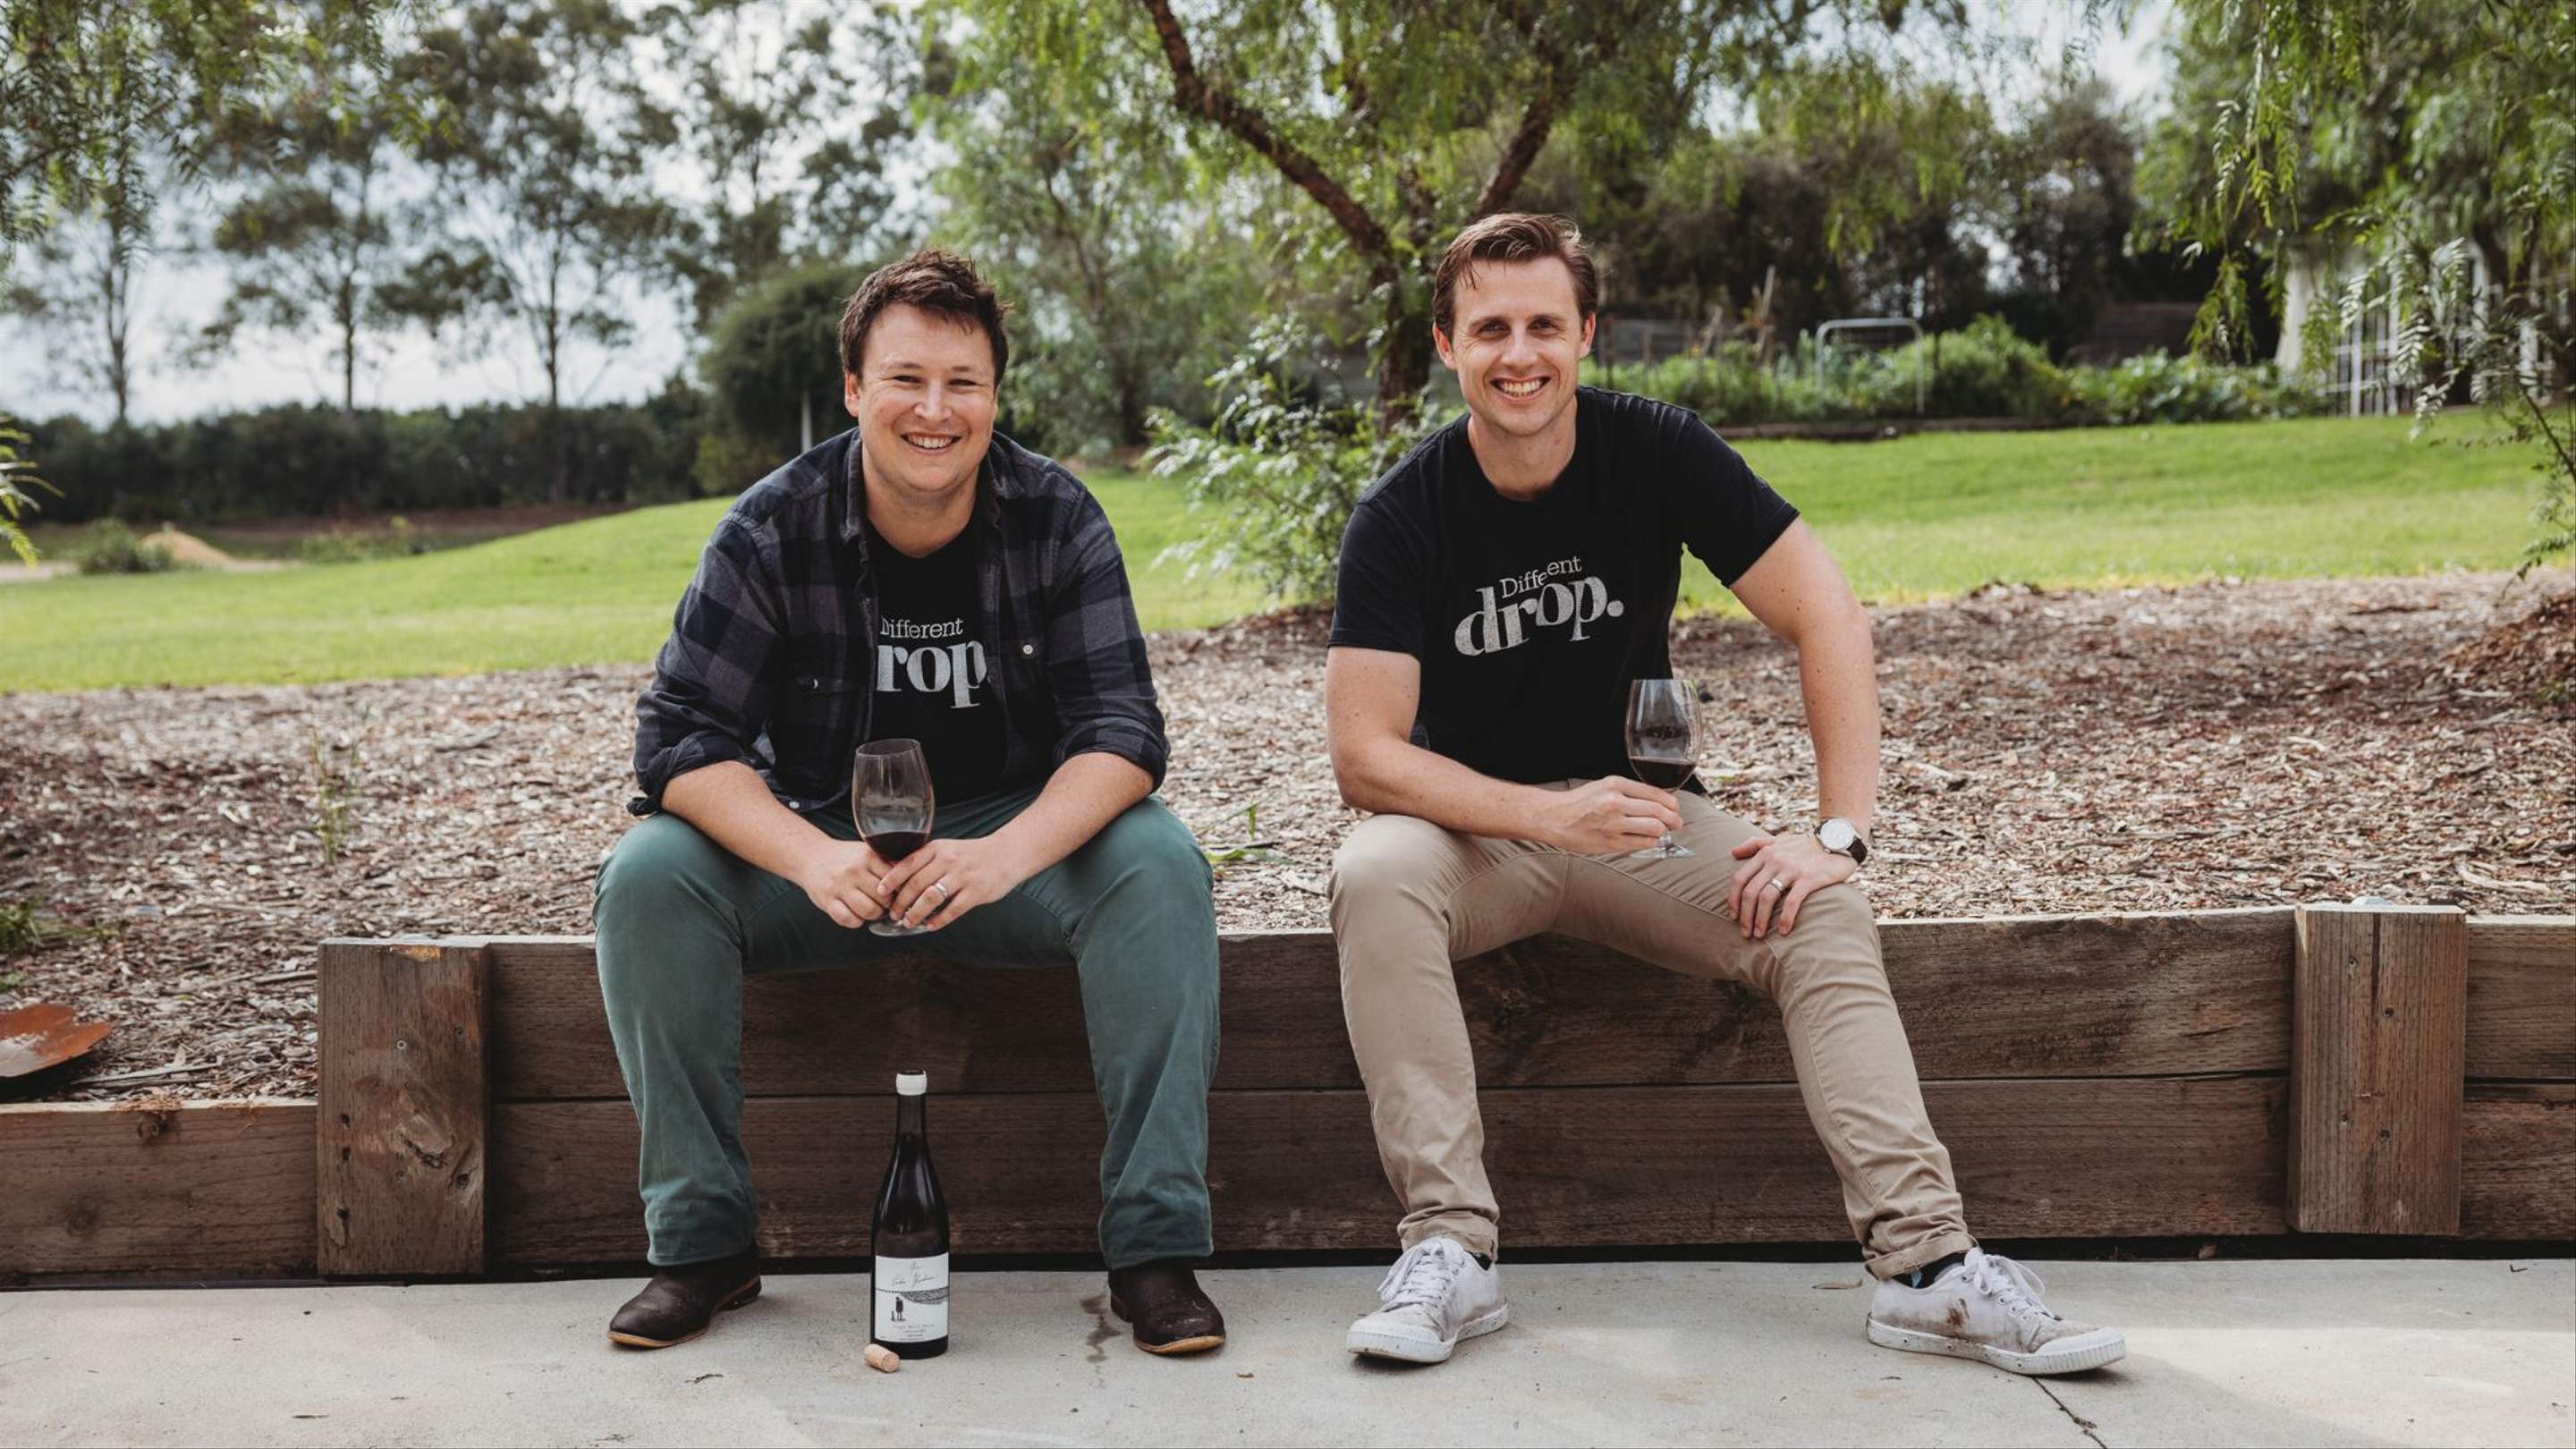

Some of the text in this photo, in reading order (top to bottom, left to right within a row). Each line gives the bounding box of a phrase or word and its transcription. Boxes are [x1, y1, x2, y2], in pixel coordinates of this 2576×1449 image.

[1499, 555, 1582, 598] Diffeent
[1454, 576, 1624, 657] drop.
[877, 640, 987, 708] rop
